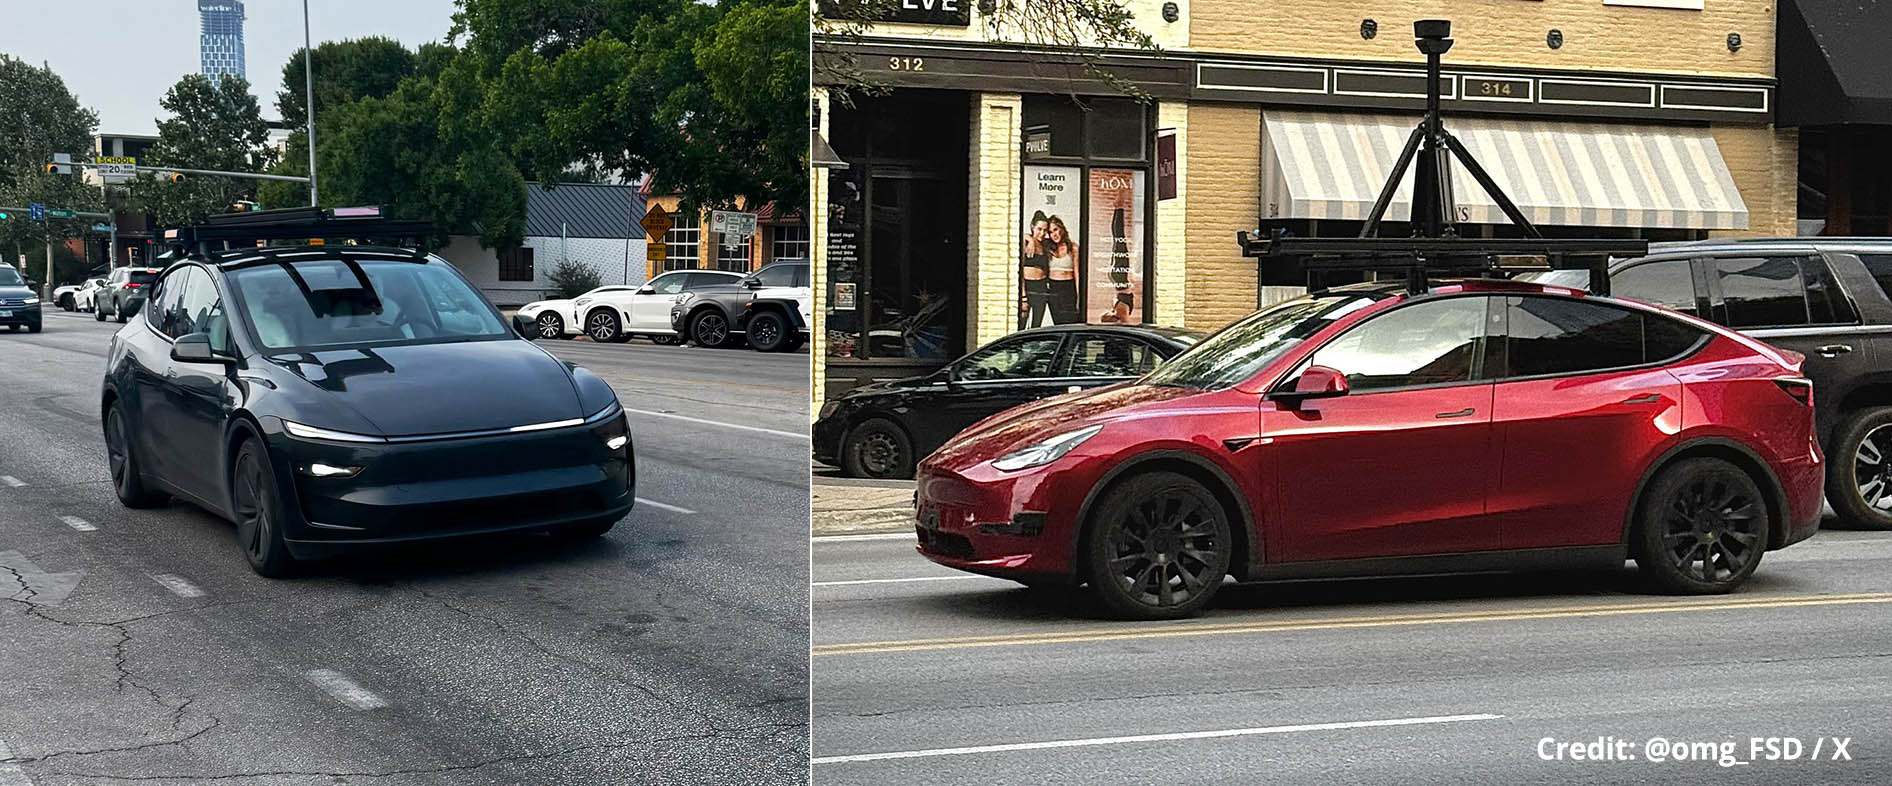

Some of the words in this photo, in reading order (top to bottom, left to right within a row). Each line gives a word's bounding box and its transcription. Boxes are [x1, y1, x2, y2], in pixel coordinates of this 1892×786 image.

[890, 56, 923, 71] 312
[1481, 82, 1512, 96] 314
[109, 165, 120, 173] 20
[1038, 172, 1065, 181] Learn
[1039, 182, 1064, 191] More
